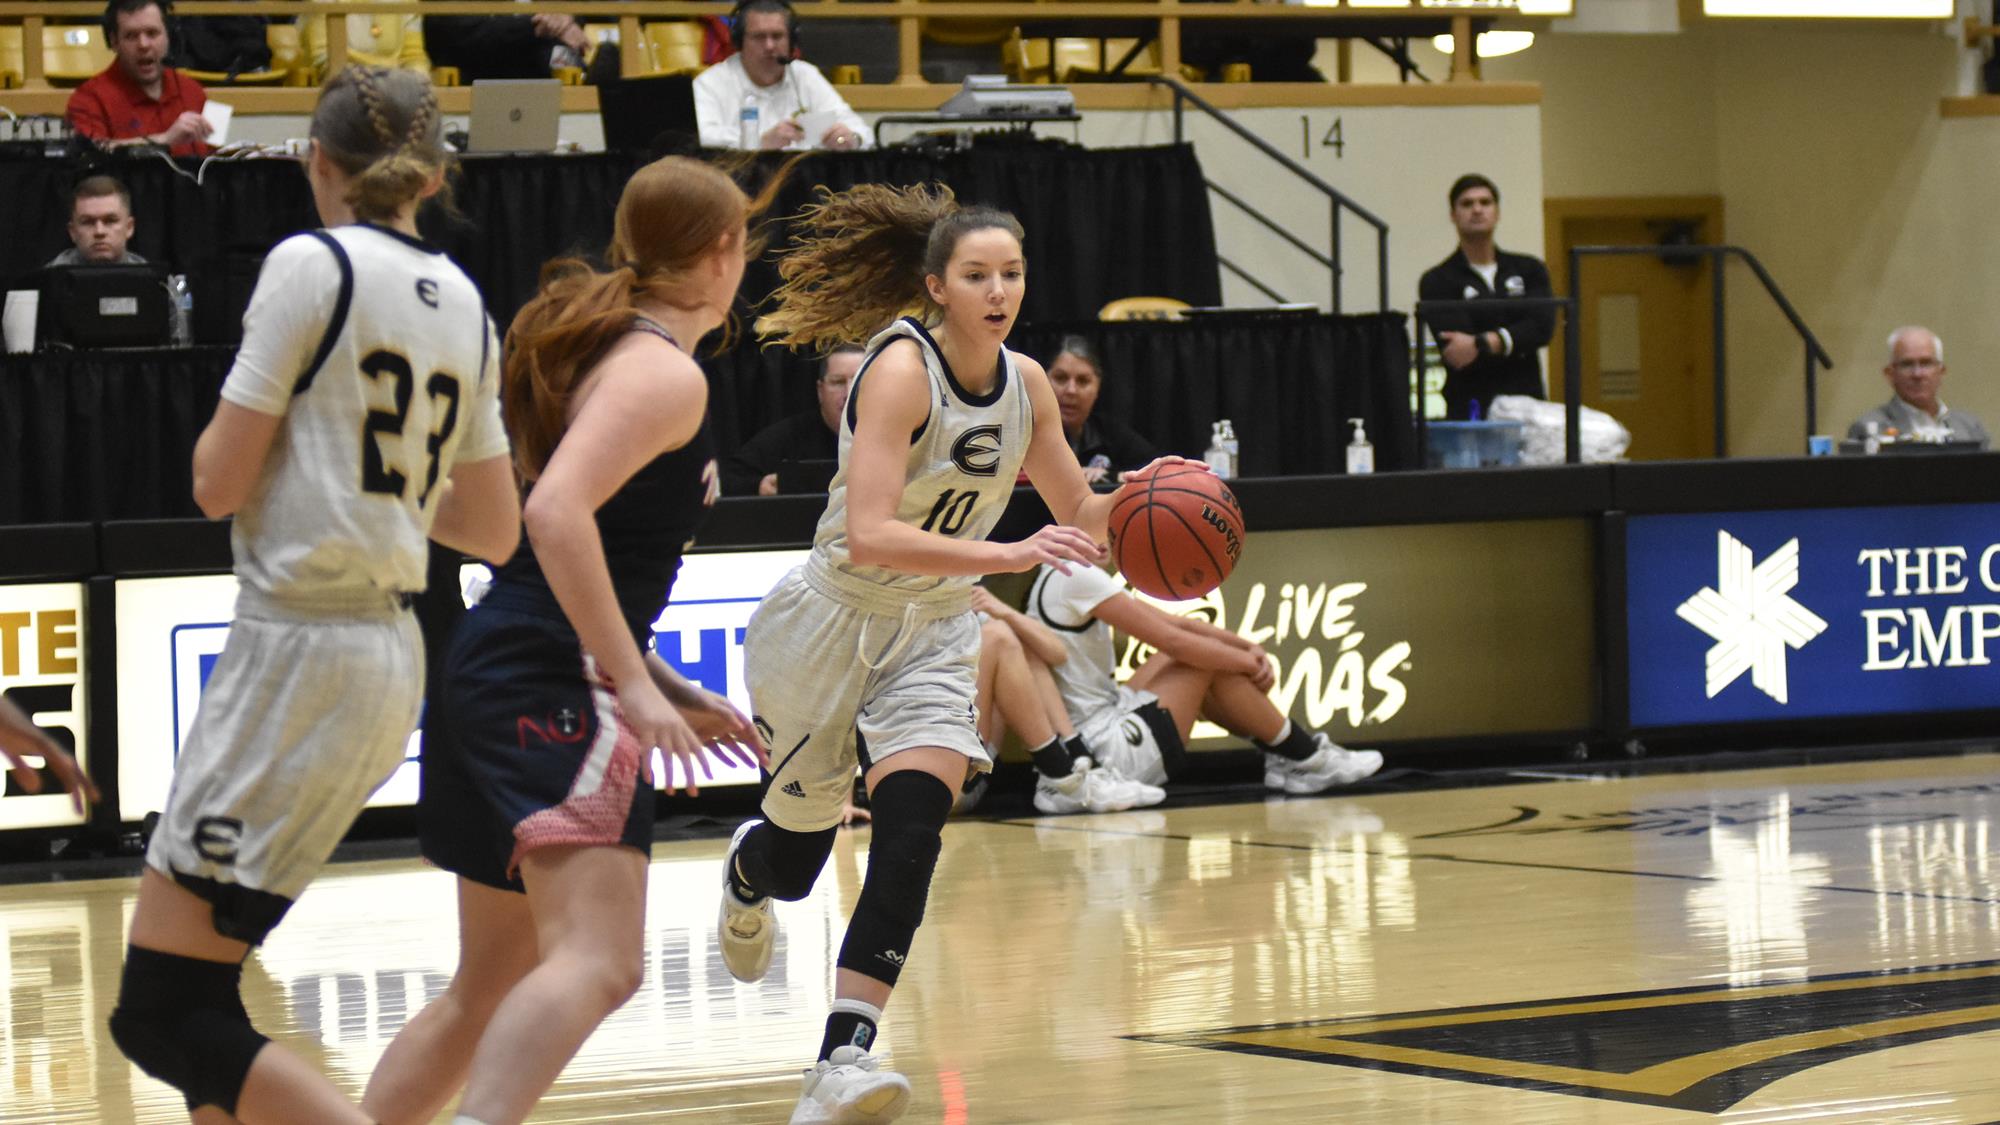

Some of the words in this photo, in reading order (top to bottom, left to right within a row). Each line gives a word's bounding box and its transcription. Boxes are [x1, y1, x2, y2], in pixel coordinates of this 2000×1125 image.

[1301, 115, 1345, 159] 14
[921, 488, 979, 535] 10
[1202, 503, 1240, 564] ilson
[1857, 546, 1969, 597] THE
[0, 609, 78, 676] TE
[1860, 604, 2000, 671] EMP
